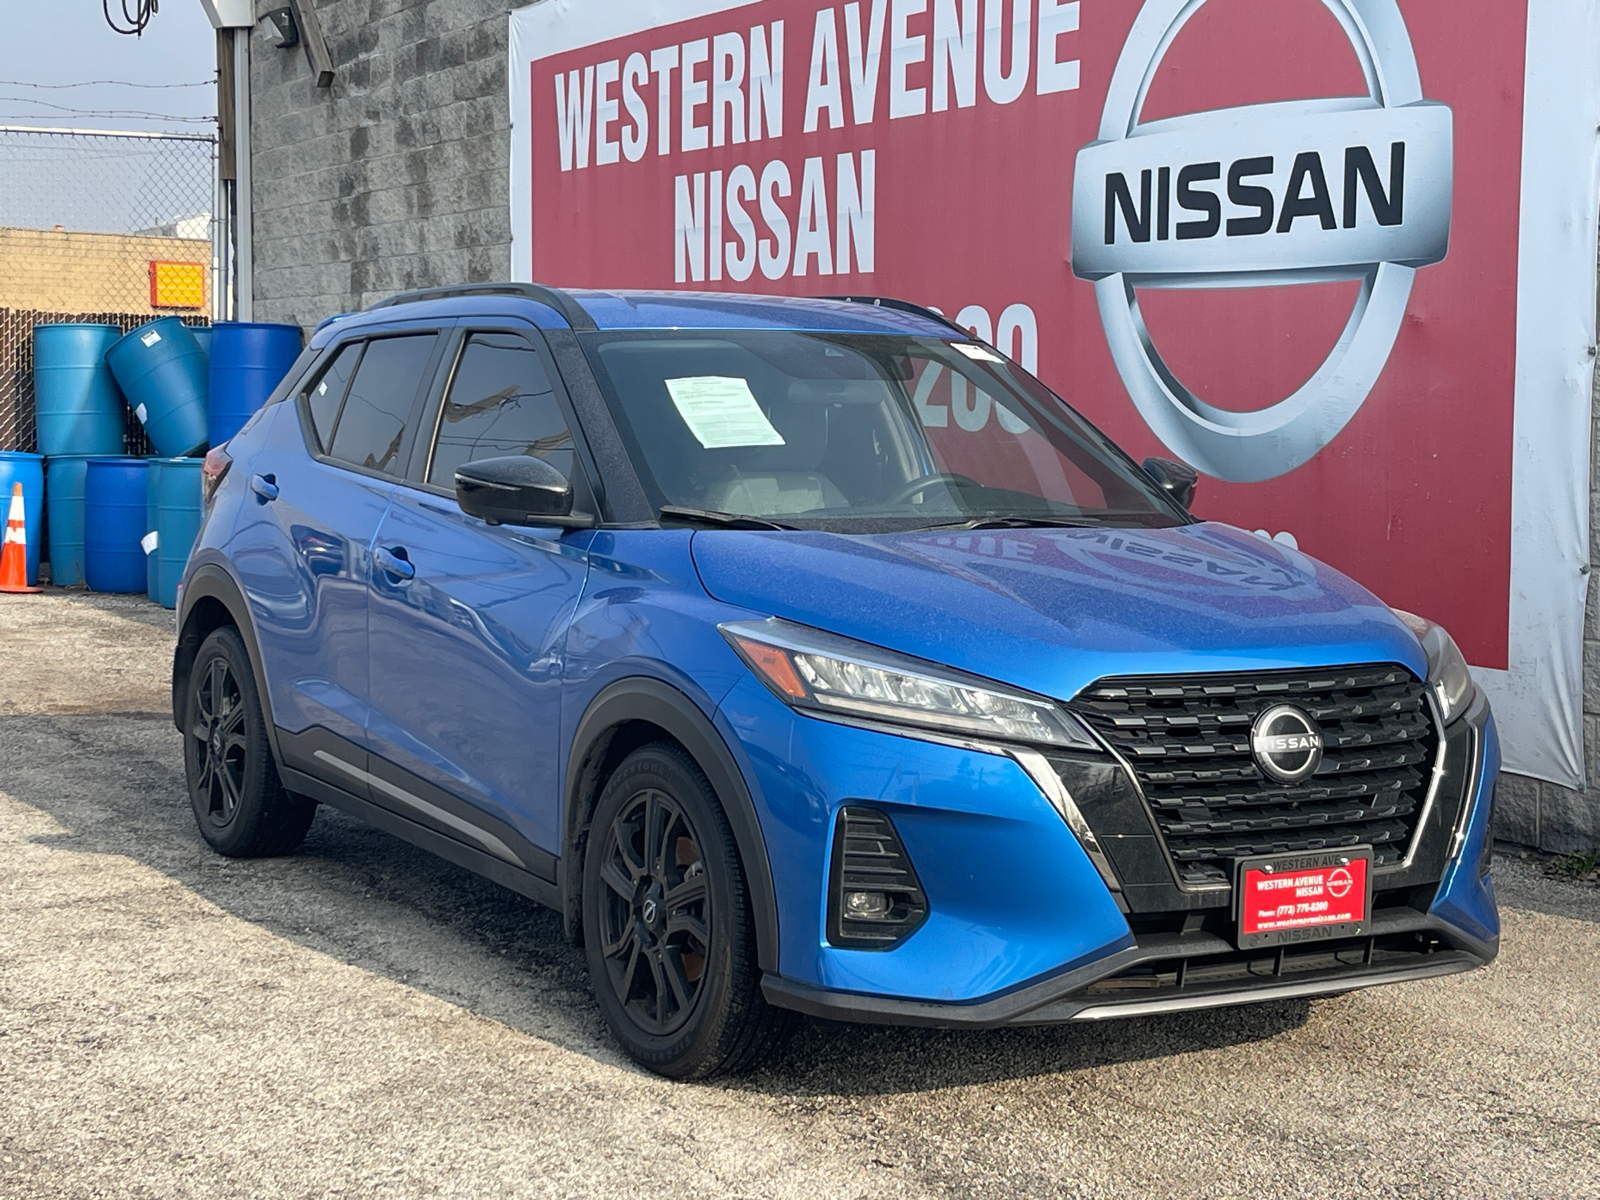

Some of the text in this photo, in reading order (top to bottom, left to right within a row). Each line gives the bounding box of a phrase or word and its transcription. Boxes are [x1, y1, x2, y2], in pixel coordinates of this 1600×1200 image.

[554, 0, 1080, 172] WESTERN AVENUE
[1104, 141, 1406, 245] NISSAN
[674, 149, 876, 283] NISSAN
[1259, 735, 1319, 750] NISSAN
[1273, 857, 1319, 872] WESTERN
[1257, 875, 1324, 891] WESTERN AVENUE
[1296, 885, 1323, 898] NISSAN
[1277, 905, 1295, 917] (773)
[1277, 926, 1332, 943] NISSAN
